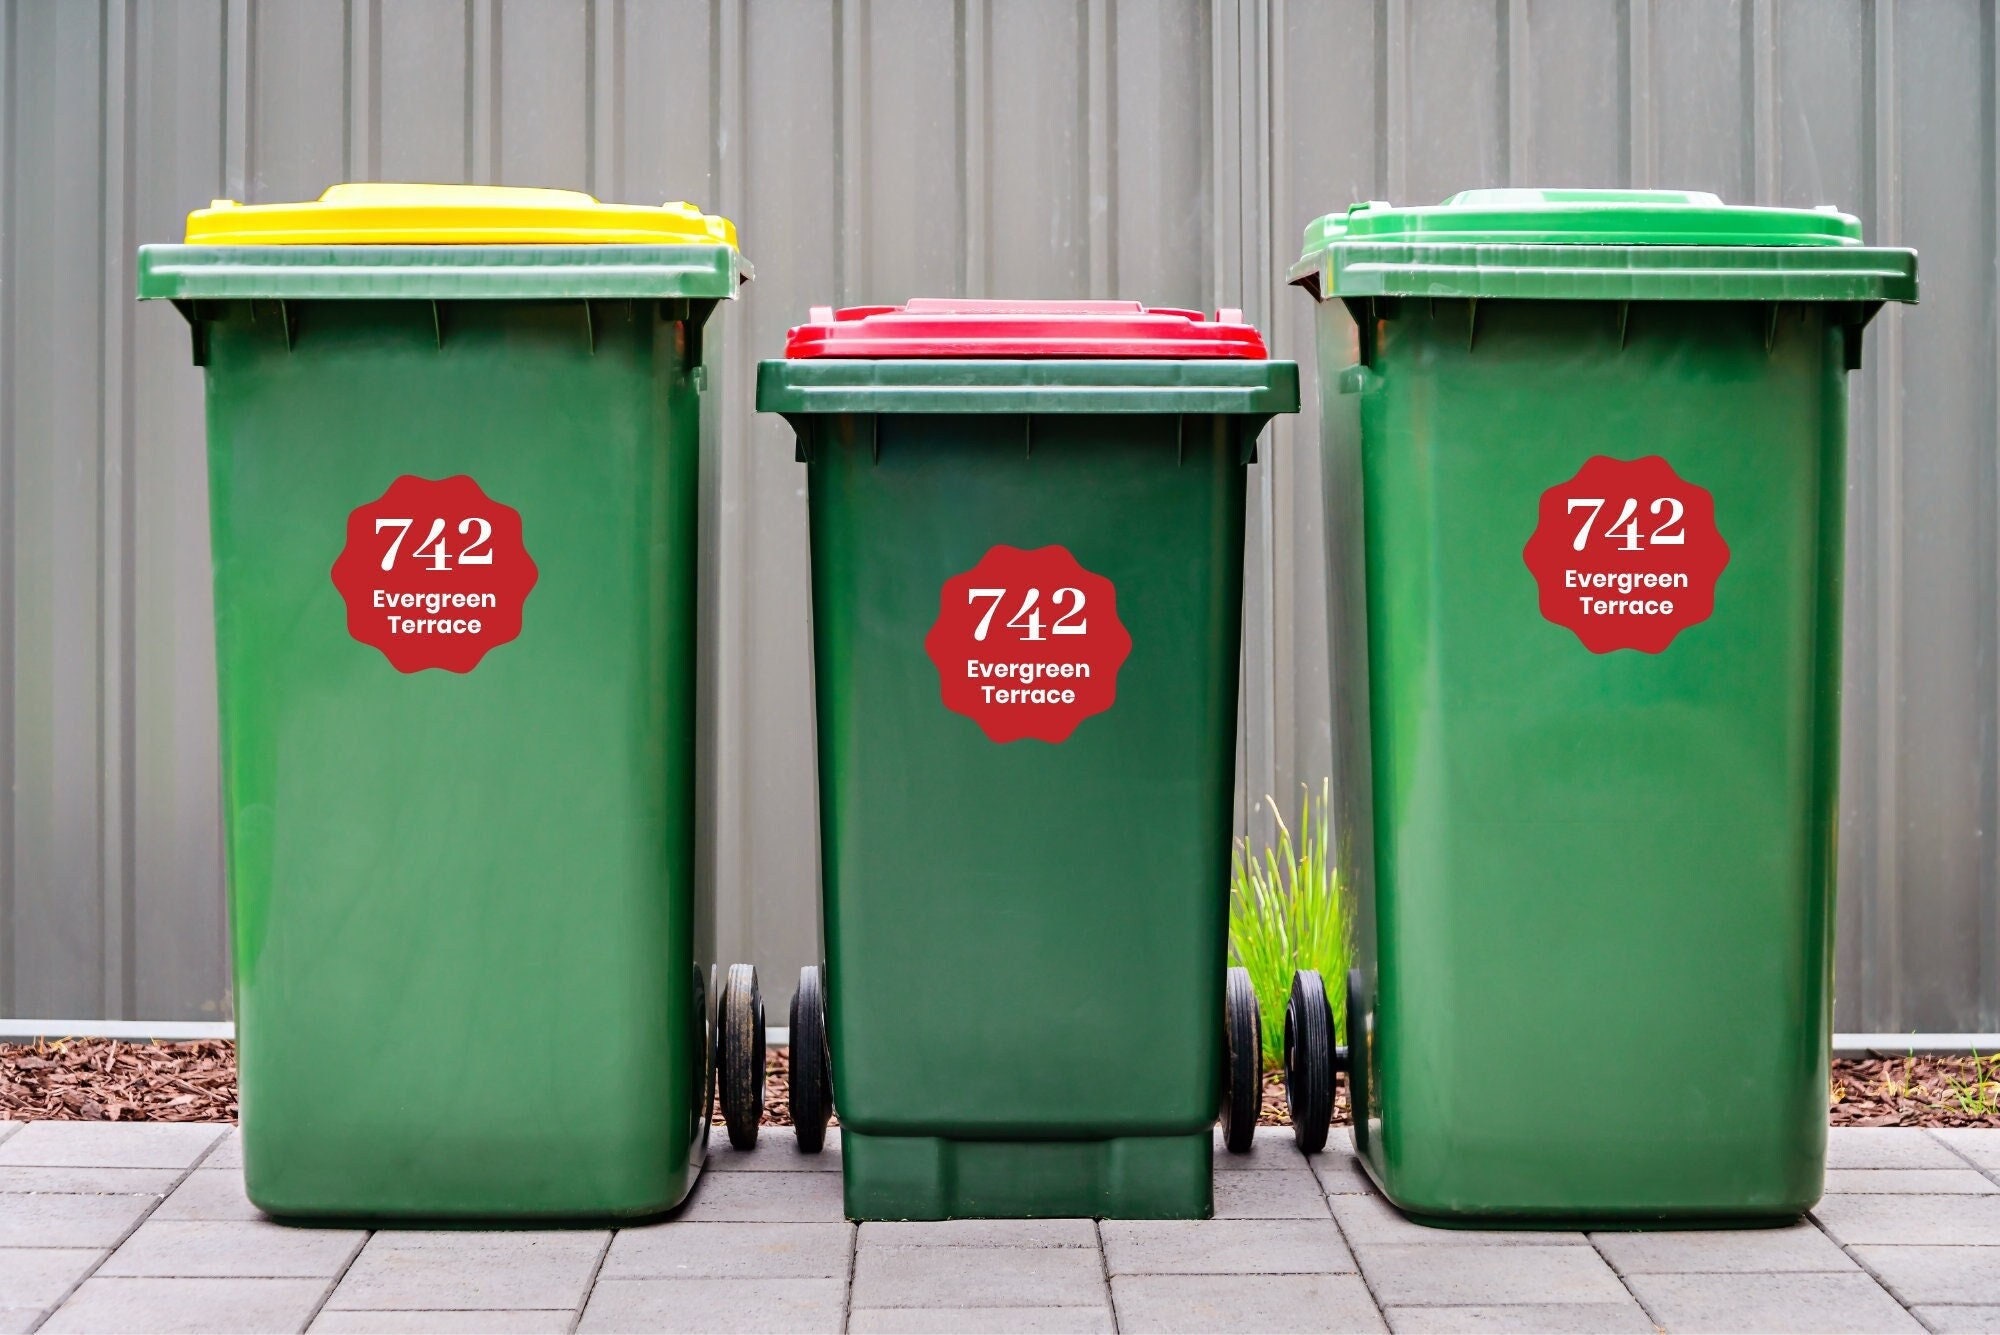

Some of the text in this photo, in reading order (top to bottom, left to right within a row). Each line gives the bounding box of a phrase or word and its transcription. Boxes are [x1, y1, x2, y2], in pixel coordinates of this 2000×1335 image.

[1567, 498, 1685, 551] 742
[375, 518, 493, 570] 742
[1565, 569, 1688, 594] Evergreen
[373, 589, 496, 613] Evergreen
[1579, 596, 1674, 615] Terrace
[387, 615, 482, 634] Terrace
[968, 588, 1087, 640] 742
[967, 659, 1090, 684] Evergreen
[981, 685, 1076, 704] Terrace
